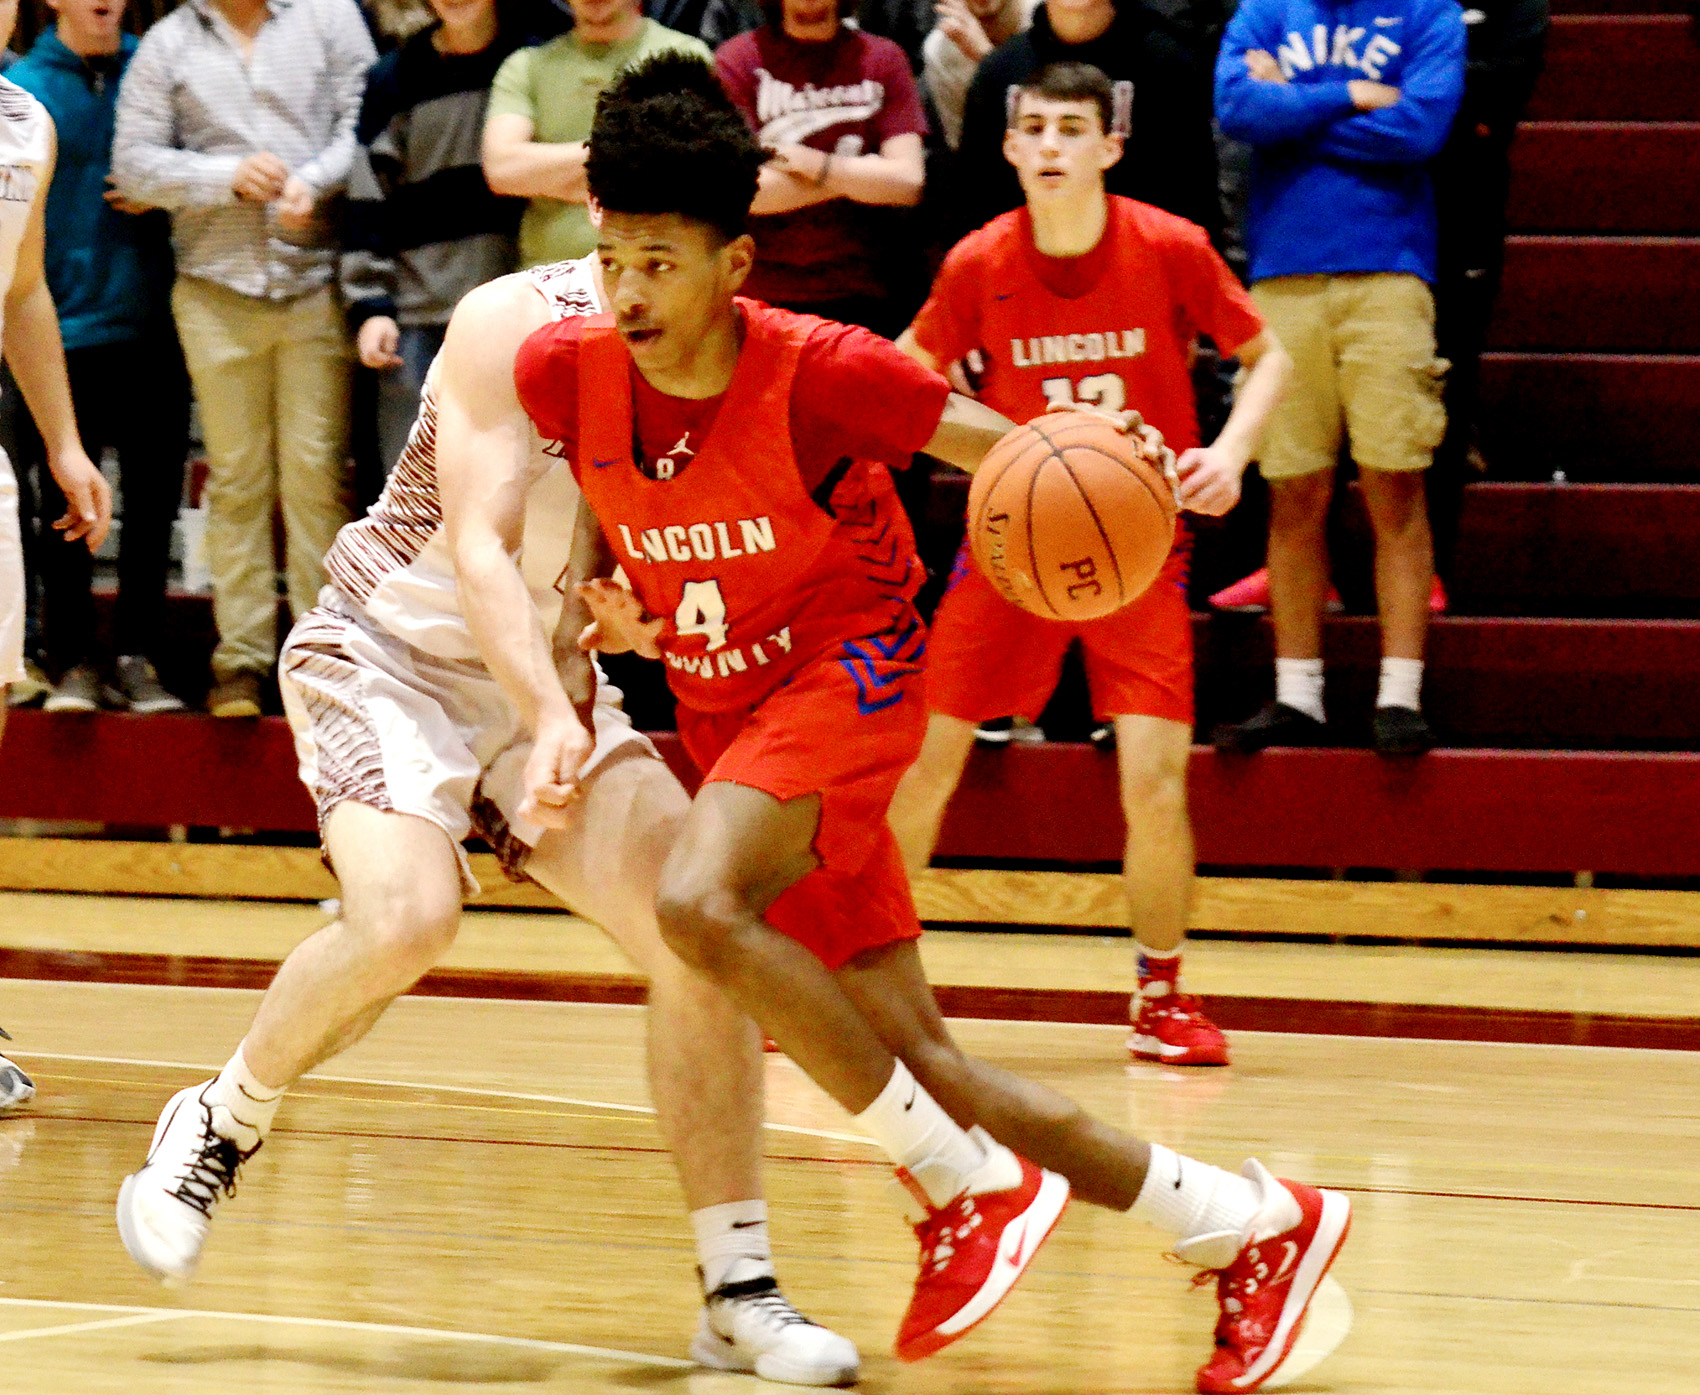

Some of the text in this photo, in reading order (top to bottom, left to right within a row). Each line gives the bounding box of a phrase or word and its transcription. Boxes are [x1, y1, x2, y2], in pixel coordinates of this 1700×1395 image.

[1277, 24, 1401, 80] NIKE
[1010, 327, 1145, 366] LINCOLN
[618, 516, 776, 564] LNCOLN
[1059, 556, 1103, 601] PC
[675, 578, 729, 652] 4
